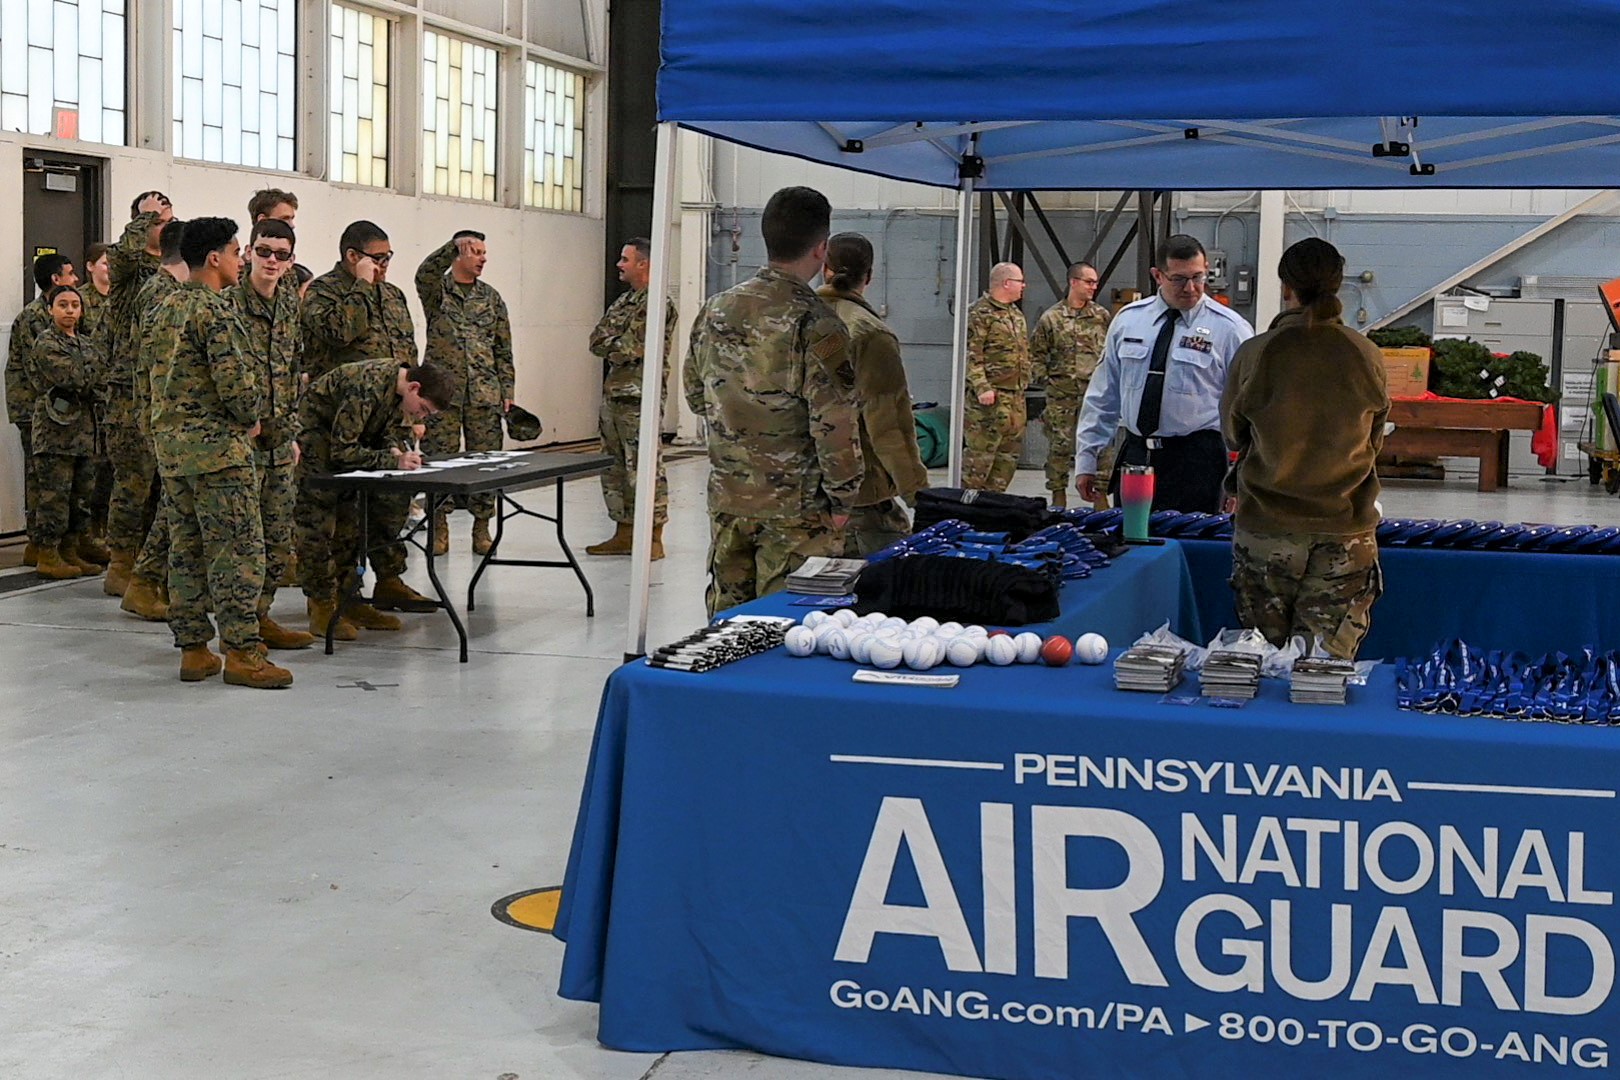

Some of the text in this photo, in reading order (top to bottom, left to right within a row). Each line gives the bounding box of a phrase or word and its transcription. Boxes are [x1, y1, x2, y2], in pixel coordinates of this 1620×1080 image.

[1014, 753, 1403, 802] PENNSYLVANIA
[833, 796, 1169, 987] AIR
[1181, 812, 1614, 905] NATIONAL
[1174, 893, 1615, 1015] GUARD
[830, 980, 1608, 1068] GoANG.com/PA 800-TO-GO-ANG
